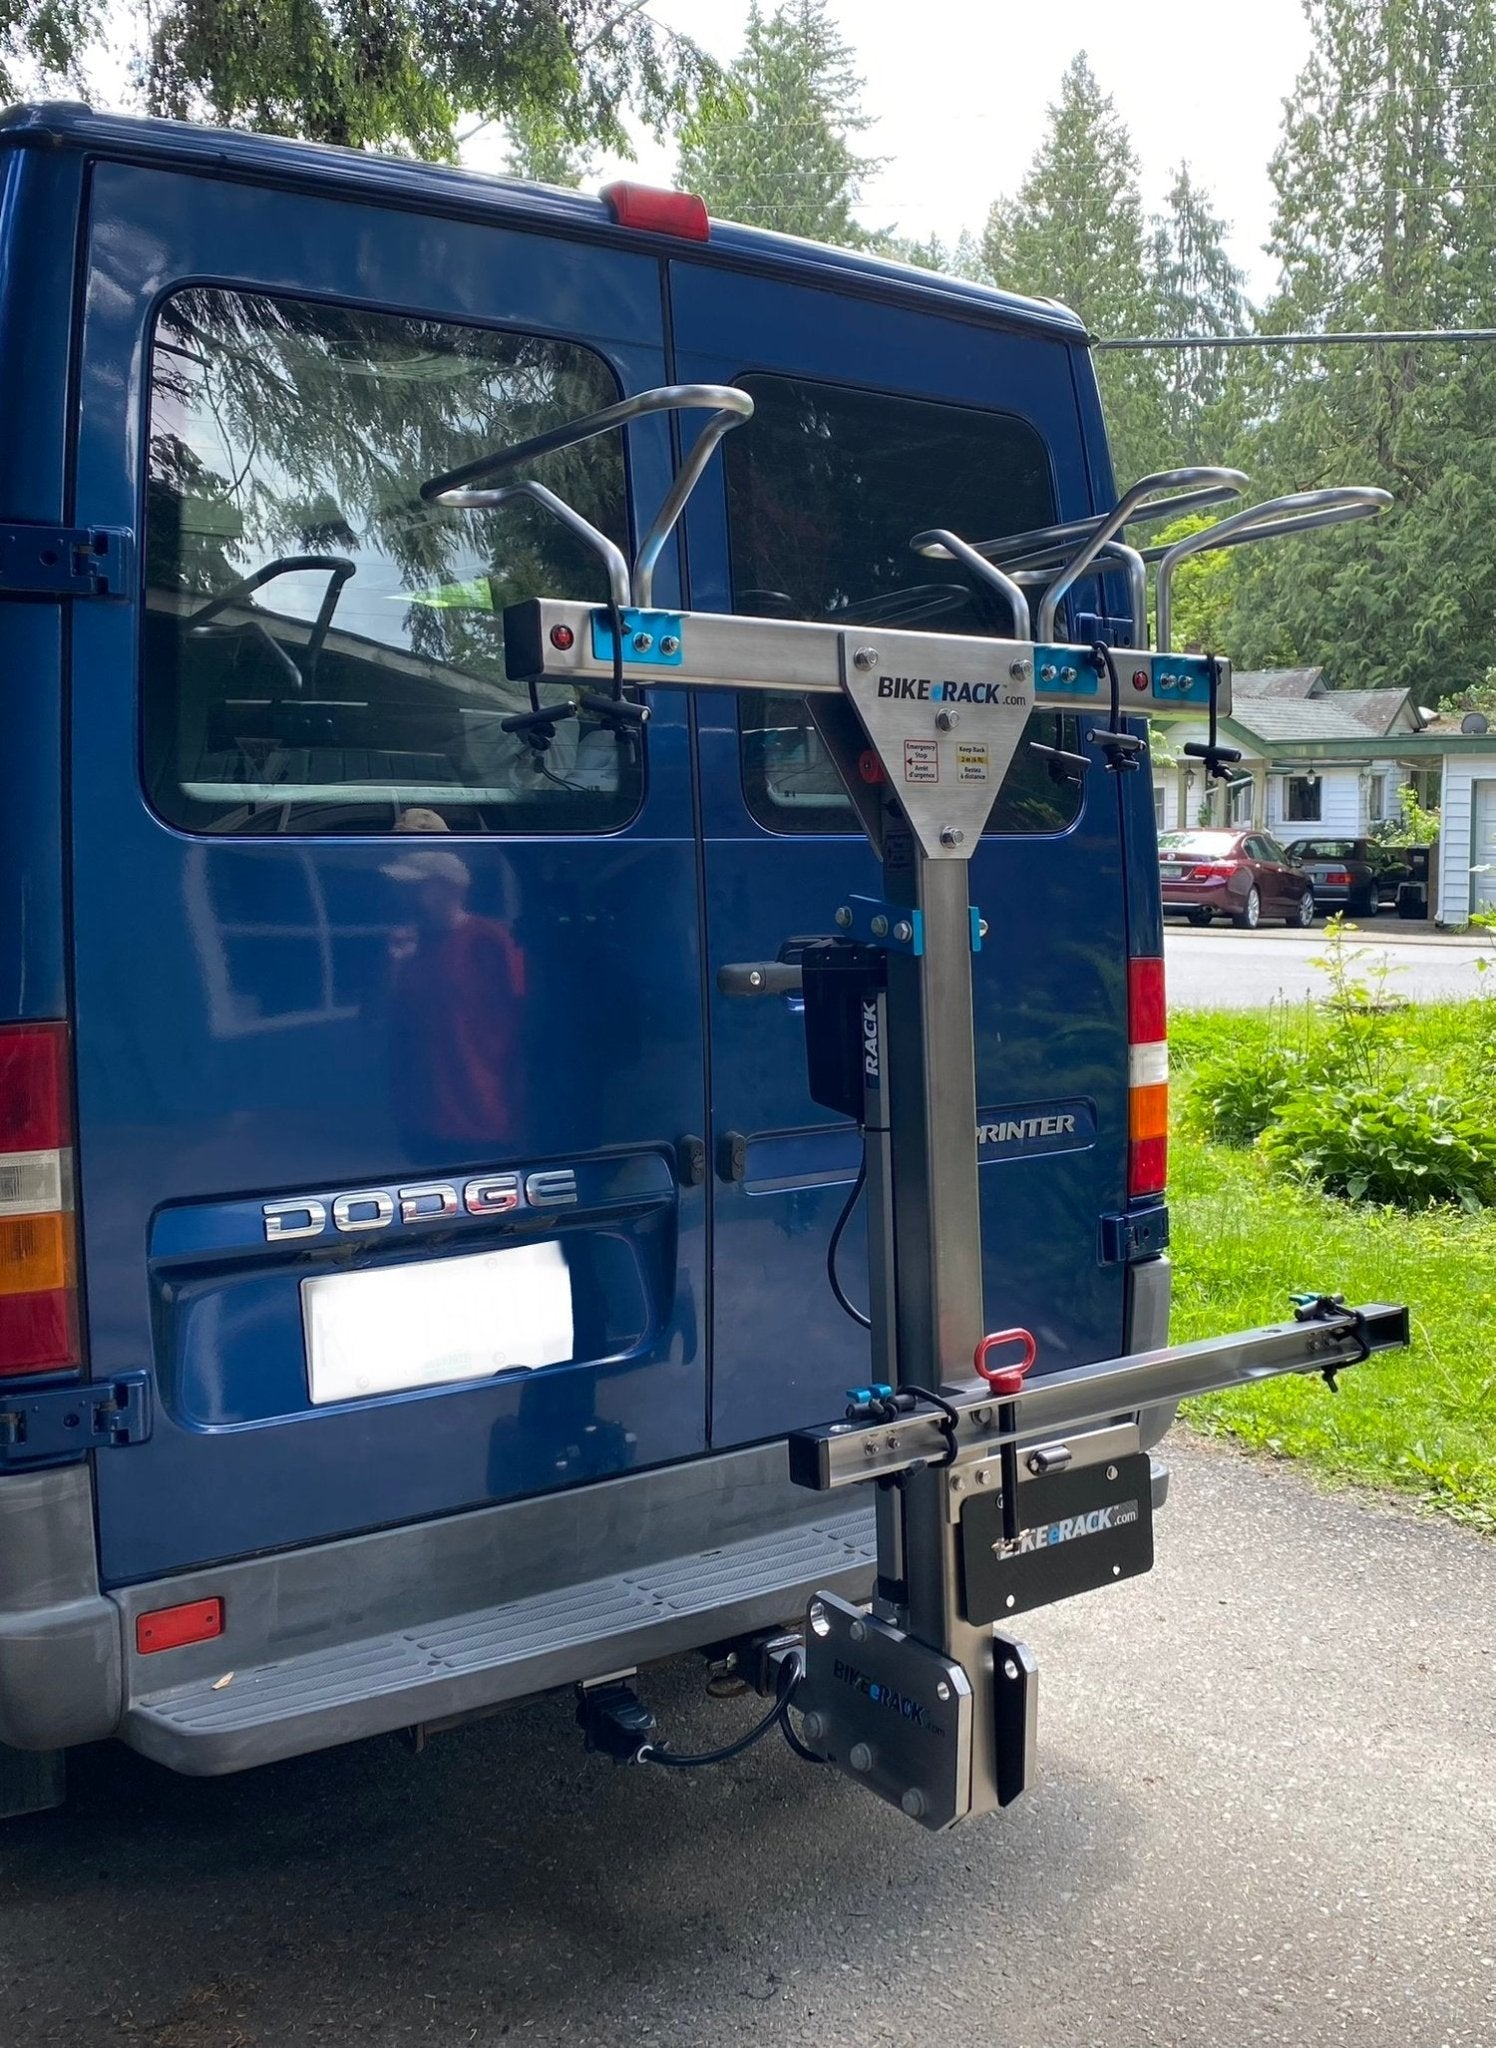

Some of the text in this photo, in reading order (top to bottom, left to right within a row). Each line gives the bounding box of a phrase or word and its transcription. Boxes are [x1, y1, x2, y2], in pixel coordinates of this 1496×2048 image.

[906, 743, 936, 752] Emergency
[914, 751, 928, 759] Stop
[262, 1169, 578, 1241] DODGE
